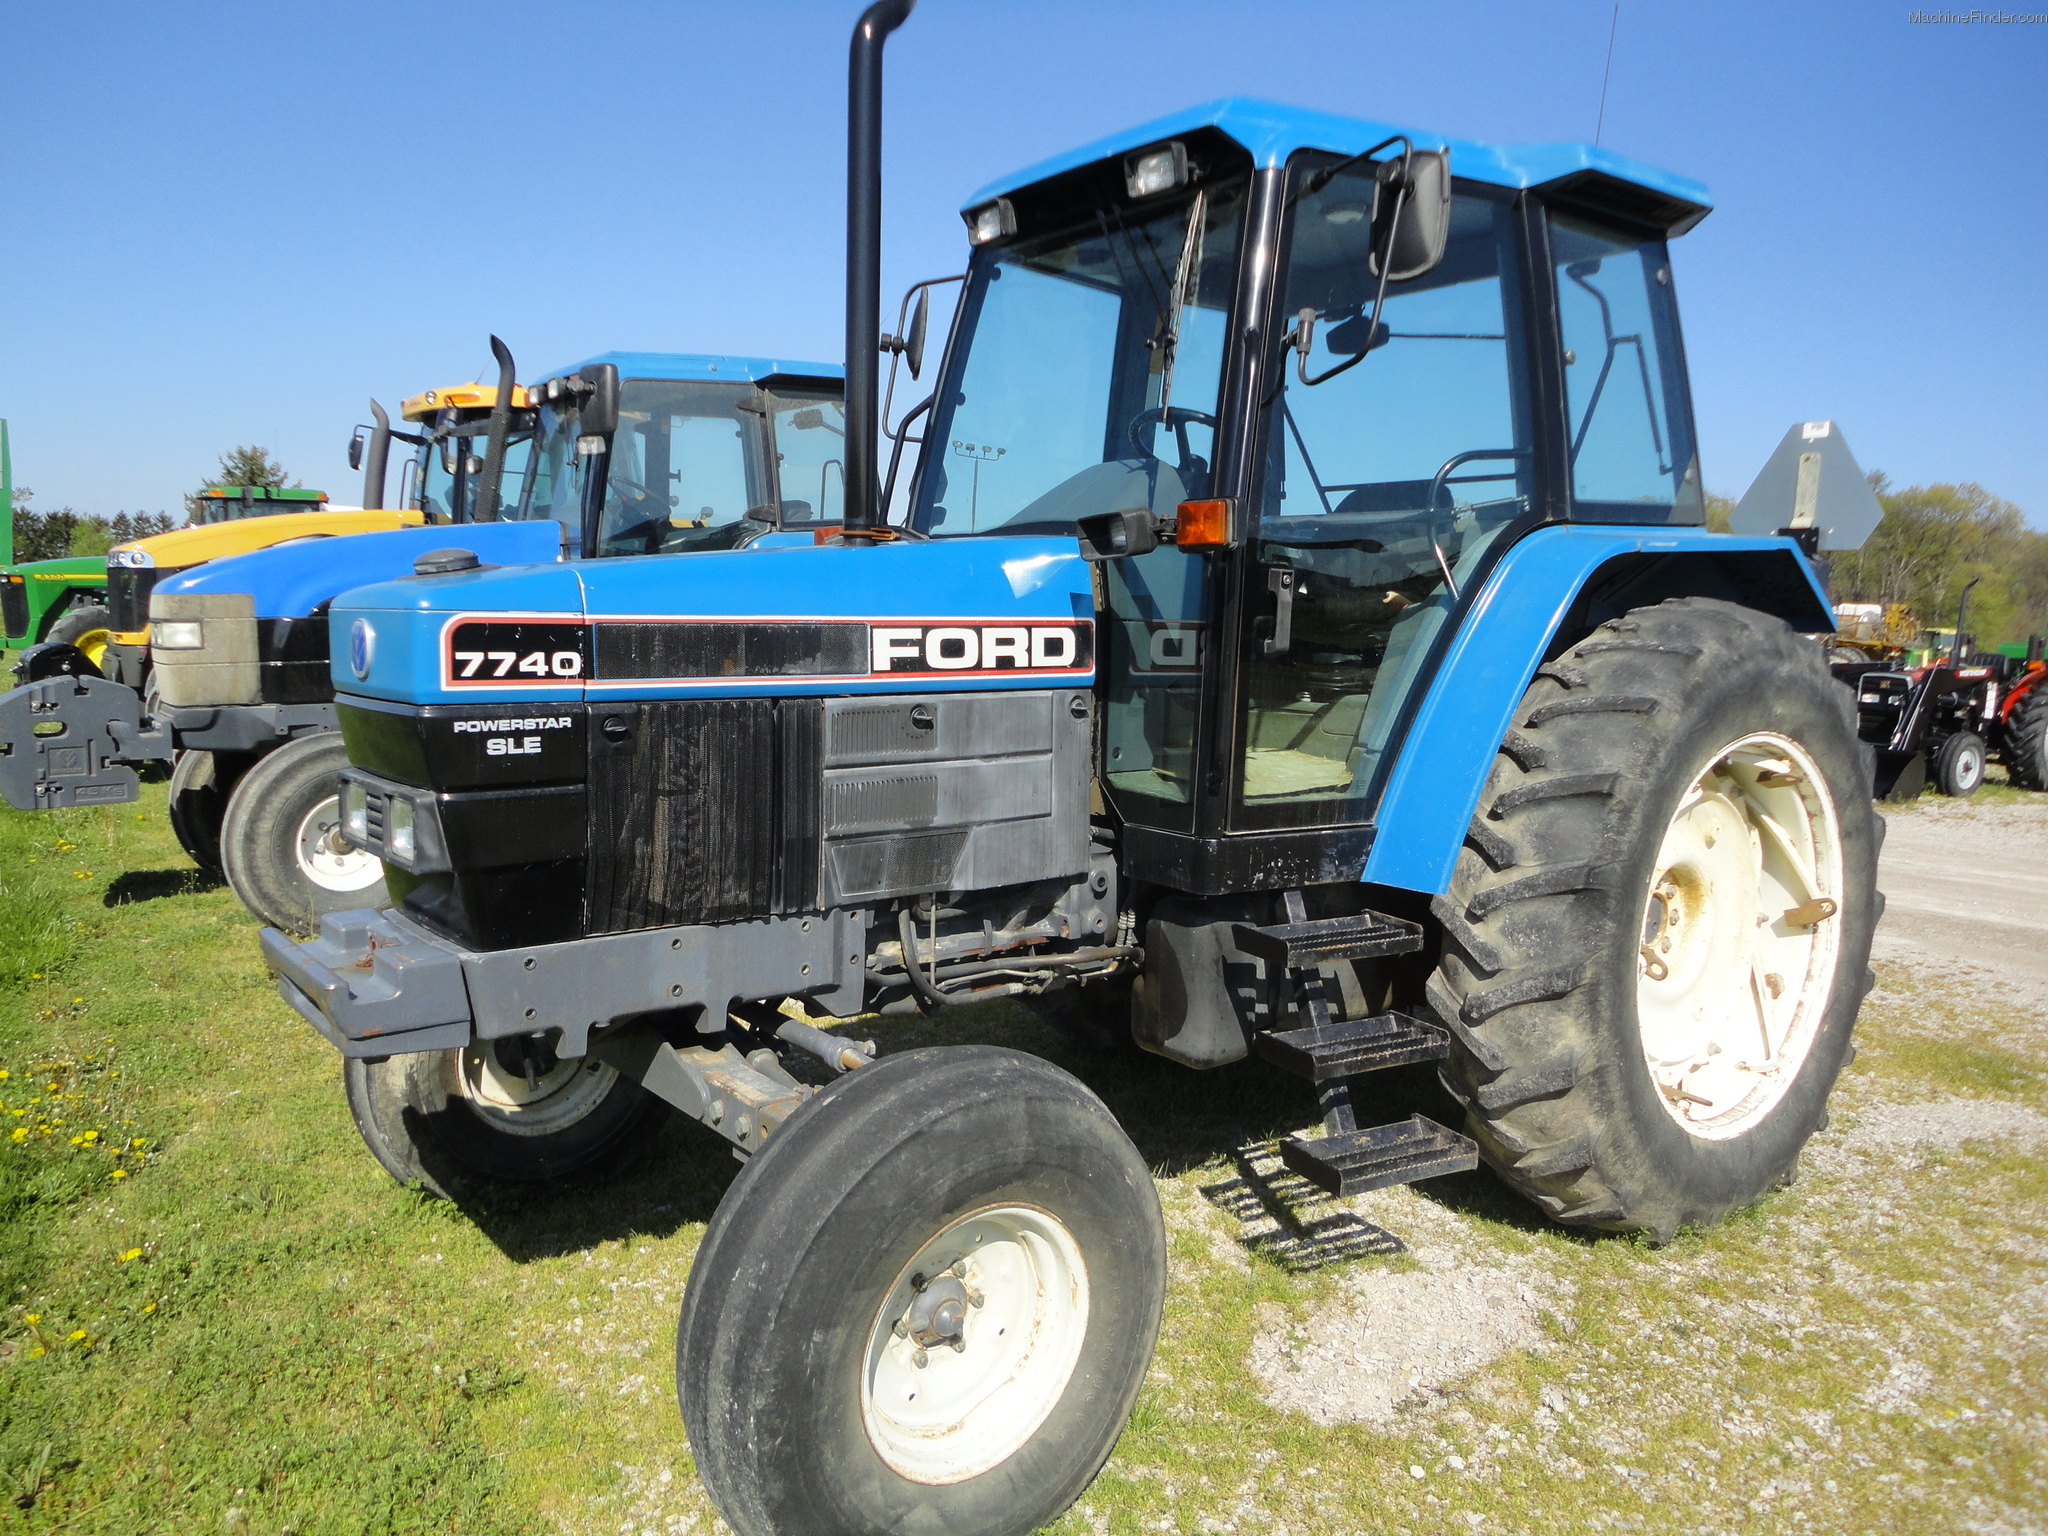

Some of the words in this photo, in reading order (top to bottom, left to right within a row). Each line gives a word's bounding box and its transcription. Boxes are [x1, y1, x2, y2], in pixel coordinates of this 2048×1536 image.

[872, 627, 1076, 671] FORD
[455, 651, 582, 677] 7740
[453, 717, 572, 733] POWERSTAR
[486, 736, 542, 755] SLE
